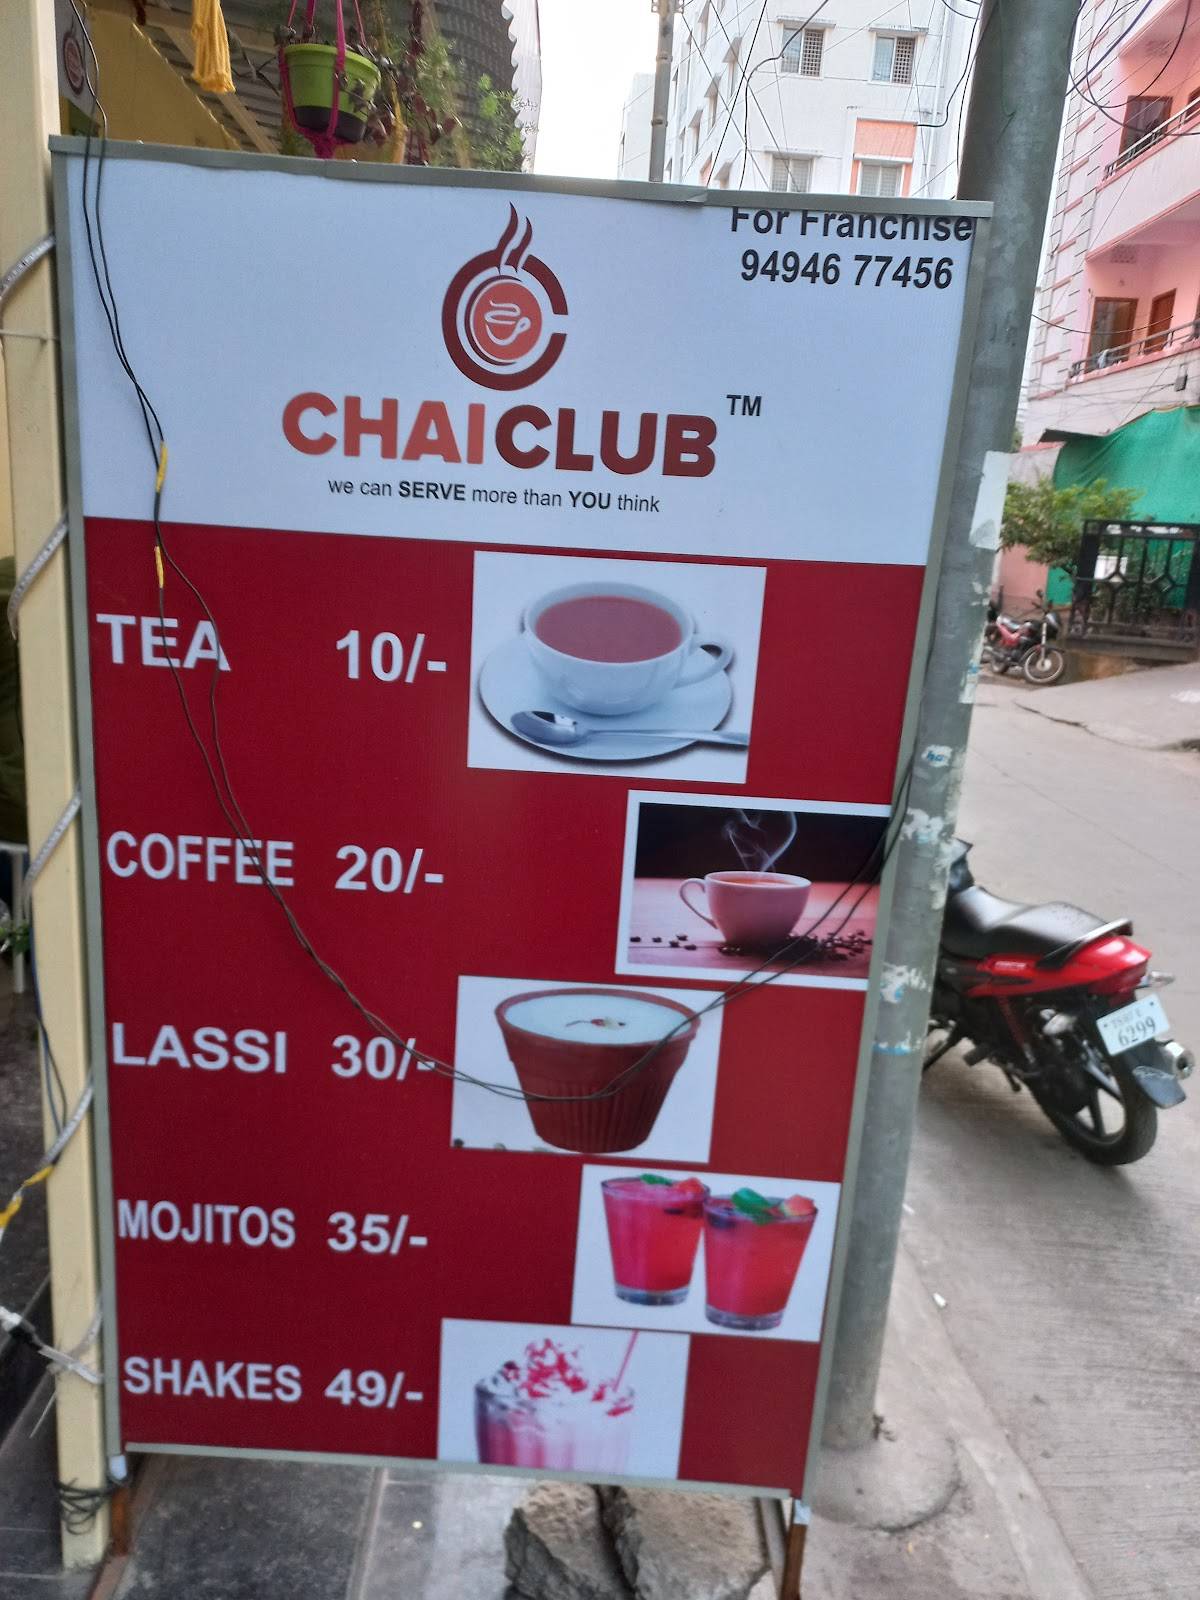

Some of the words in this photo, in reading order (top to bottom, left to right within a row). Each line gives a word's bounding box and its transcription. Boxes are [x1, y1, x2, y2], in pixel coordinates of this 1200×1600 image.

[731, 207, 790, 234] For
[800, 210, 974, 241] Franchise
[741, 249, 841, 285] 94946
[854, 255, 954, 289] 77456
[282, 391, 717, 478] CHAICLUB
[726, 394, 762, 417] TM
[328, 479, 354, 494] we
[360, 480, 392, 497] can
[399, 480, 466, 501] SERVE
[472, 487, 518, 504] more
[523, 488, 562, 507] than
[568, 490, 611, 510] YOU
[617, 493, 660, 513] think
[96, 613, 231, 672] TEA
[336, 630, 447, 684] 10/-
[107, 830, 294, 887] COFFEE
[335, 844, 444, 894] 20/-
[112, 1022, 287, 1074] LASSI
[331, 1034, 436, 1081] 30/-
[1117, 1016, 1156, 1046] 6299
[118, 1199, 296, 1248] MOJITOS
[327, 1211, 428, 1255] 35/-
[124, 1356, 302, 1403] SHAKES
[325, 1368, 423, 1409] 49/-
